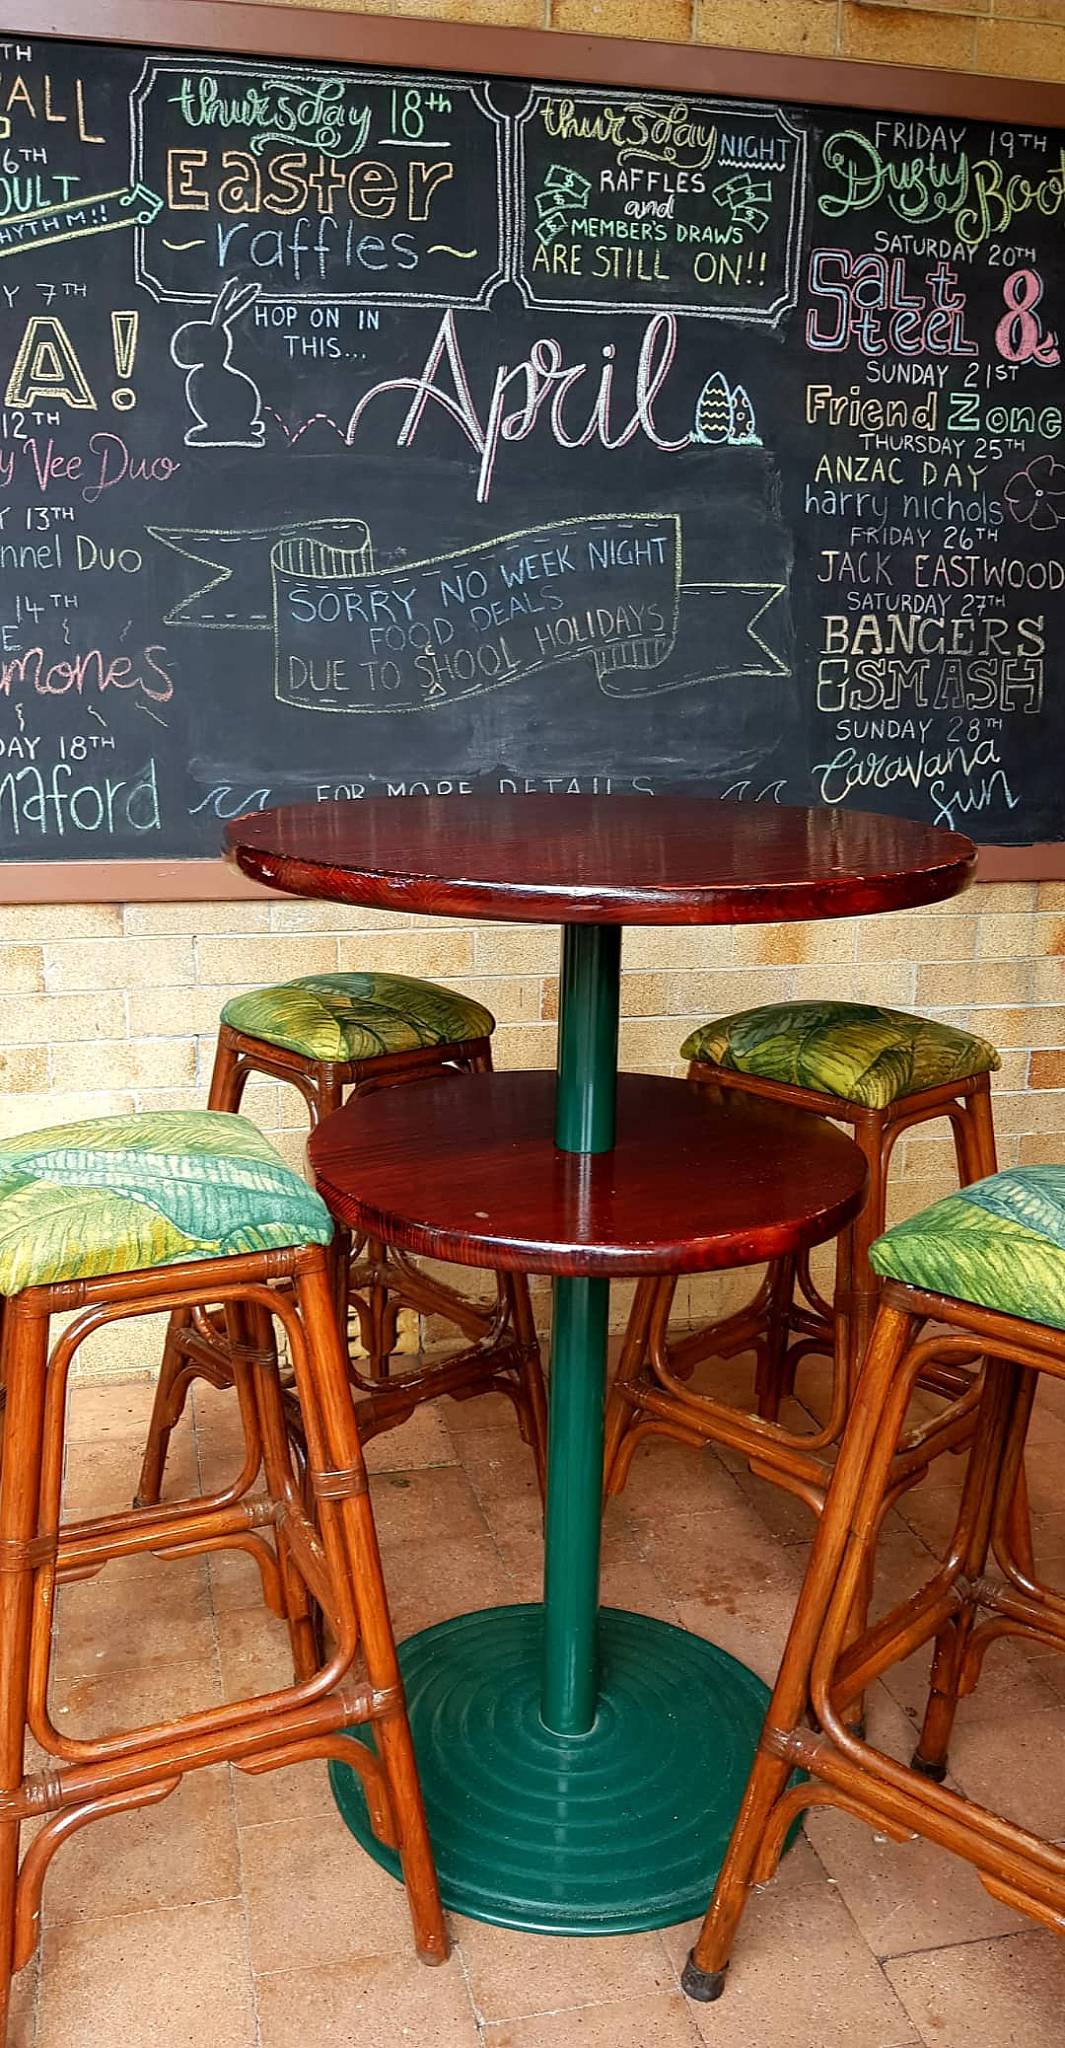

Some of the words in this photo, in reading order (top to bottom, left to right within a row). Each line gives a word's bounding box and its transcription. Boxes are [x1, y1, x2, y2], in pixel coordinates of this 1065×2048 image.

[168, 76, 372, 158] thursday
[391, 88, 452, 138] 18th
[538, 99, 718, 171] thursday
[719, 133, 791, 162] NIGHT
[875, 121, 967, 154] FRIDAY
[988, 129, 1047, 159] 19TH
[167, 149, 454, 221] Easter
[599, 168, 706, 194] RAFFLES
[818, 130, 968, 225] Dusty
[623, 194, 675, 220] and
[215, 216, 419, 281] raffles
[570, 217, 668, 241] MEMBER'S
[676, 223, 744, 245] DRAWS
[873, 230, 979, 264] SATURDAY
[988, 244, 1037, 267] 20TH
[532, 244, 583, 276] ARE
[592, 246, 671, 281] STILL
[694, 251, 767, 287] ON!!
[255, 306, 299, 329] HOP
[311, 307, 341, 328] ON
[358, 309, 380, 330] IN
[284, 336, 368, 361] THIS...
[866, 361, 950, 388] SUNDAY
[963, 364, 1021, 388] 21ST
[346, 307, 690, 504] April
[806, 384, 938, 431] Friend
[947, 392, 1063, 439] Zone
[23, 437, 84, 492] Vee
[859, 433, 966, 460] THURSDAY
[973, 438, 1026, 460] 25TH
[814, 454, 905, 485] ANZAC
[922, 462, 990, 493] DAY
[805, 484, 889, 534] harry
[902, 490, 1004, 526] nichols
[850, 528, 931, 549] FRIDAY
[943, 526, 999, 551] 26TH
[288, 587, 417, 623] SORRY
[440, 570, 488, 607] NO
[500, 544, 576, 589] WEEK
[588, 537, 669, 572] NIGHT
[817, 550, 894, 587] JACK
[914, 554, 1065, 591] EASTWOOD
[369, 617, 454, 655] FOOD
[469, 584, 564, 633] DEALS
[847, 591, 954, 617] SATURDAY
[959, 592, 1007, 617] 27TH
[289, 655, 350, 692] DUE
[358, 660, 401, 692] TO
[533, 603, 665, 656] HOLIDAYS
[835, 718, 933, 743] SUNDAY
[945, 716, 1003, 743] 28TH
